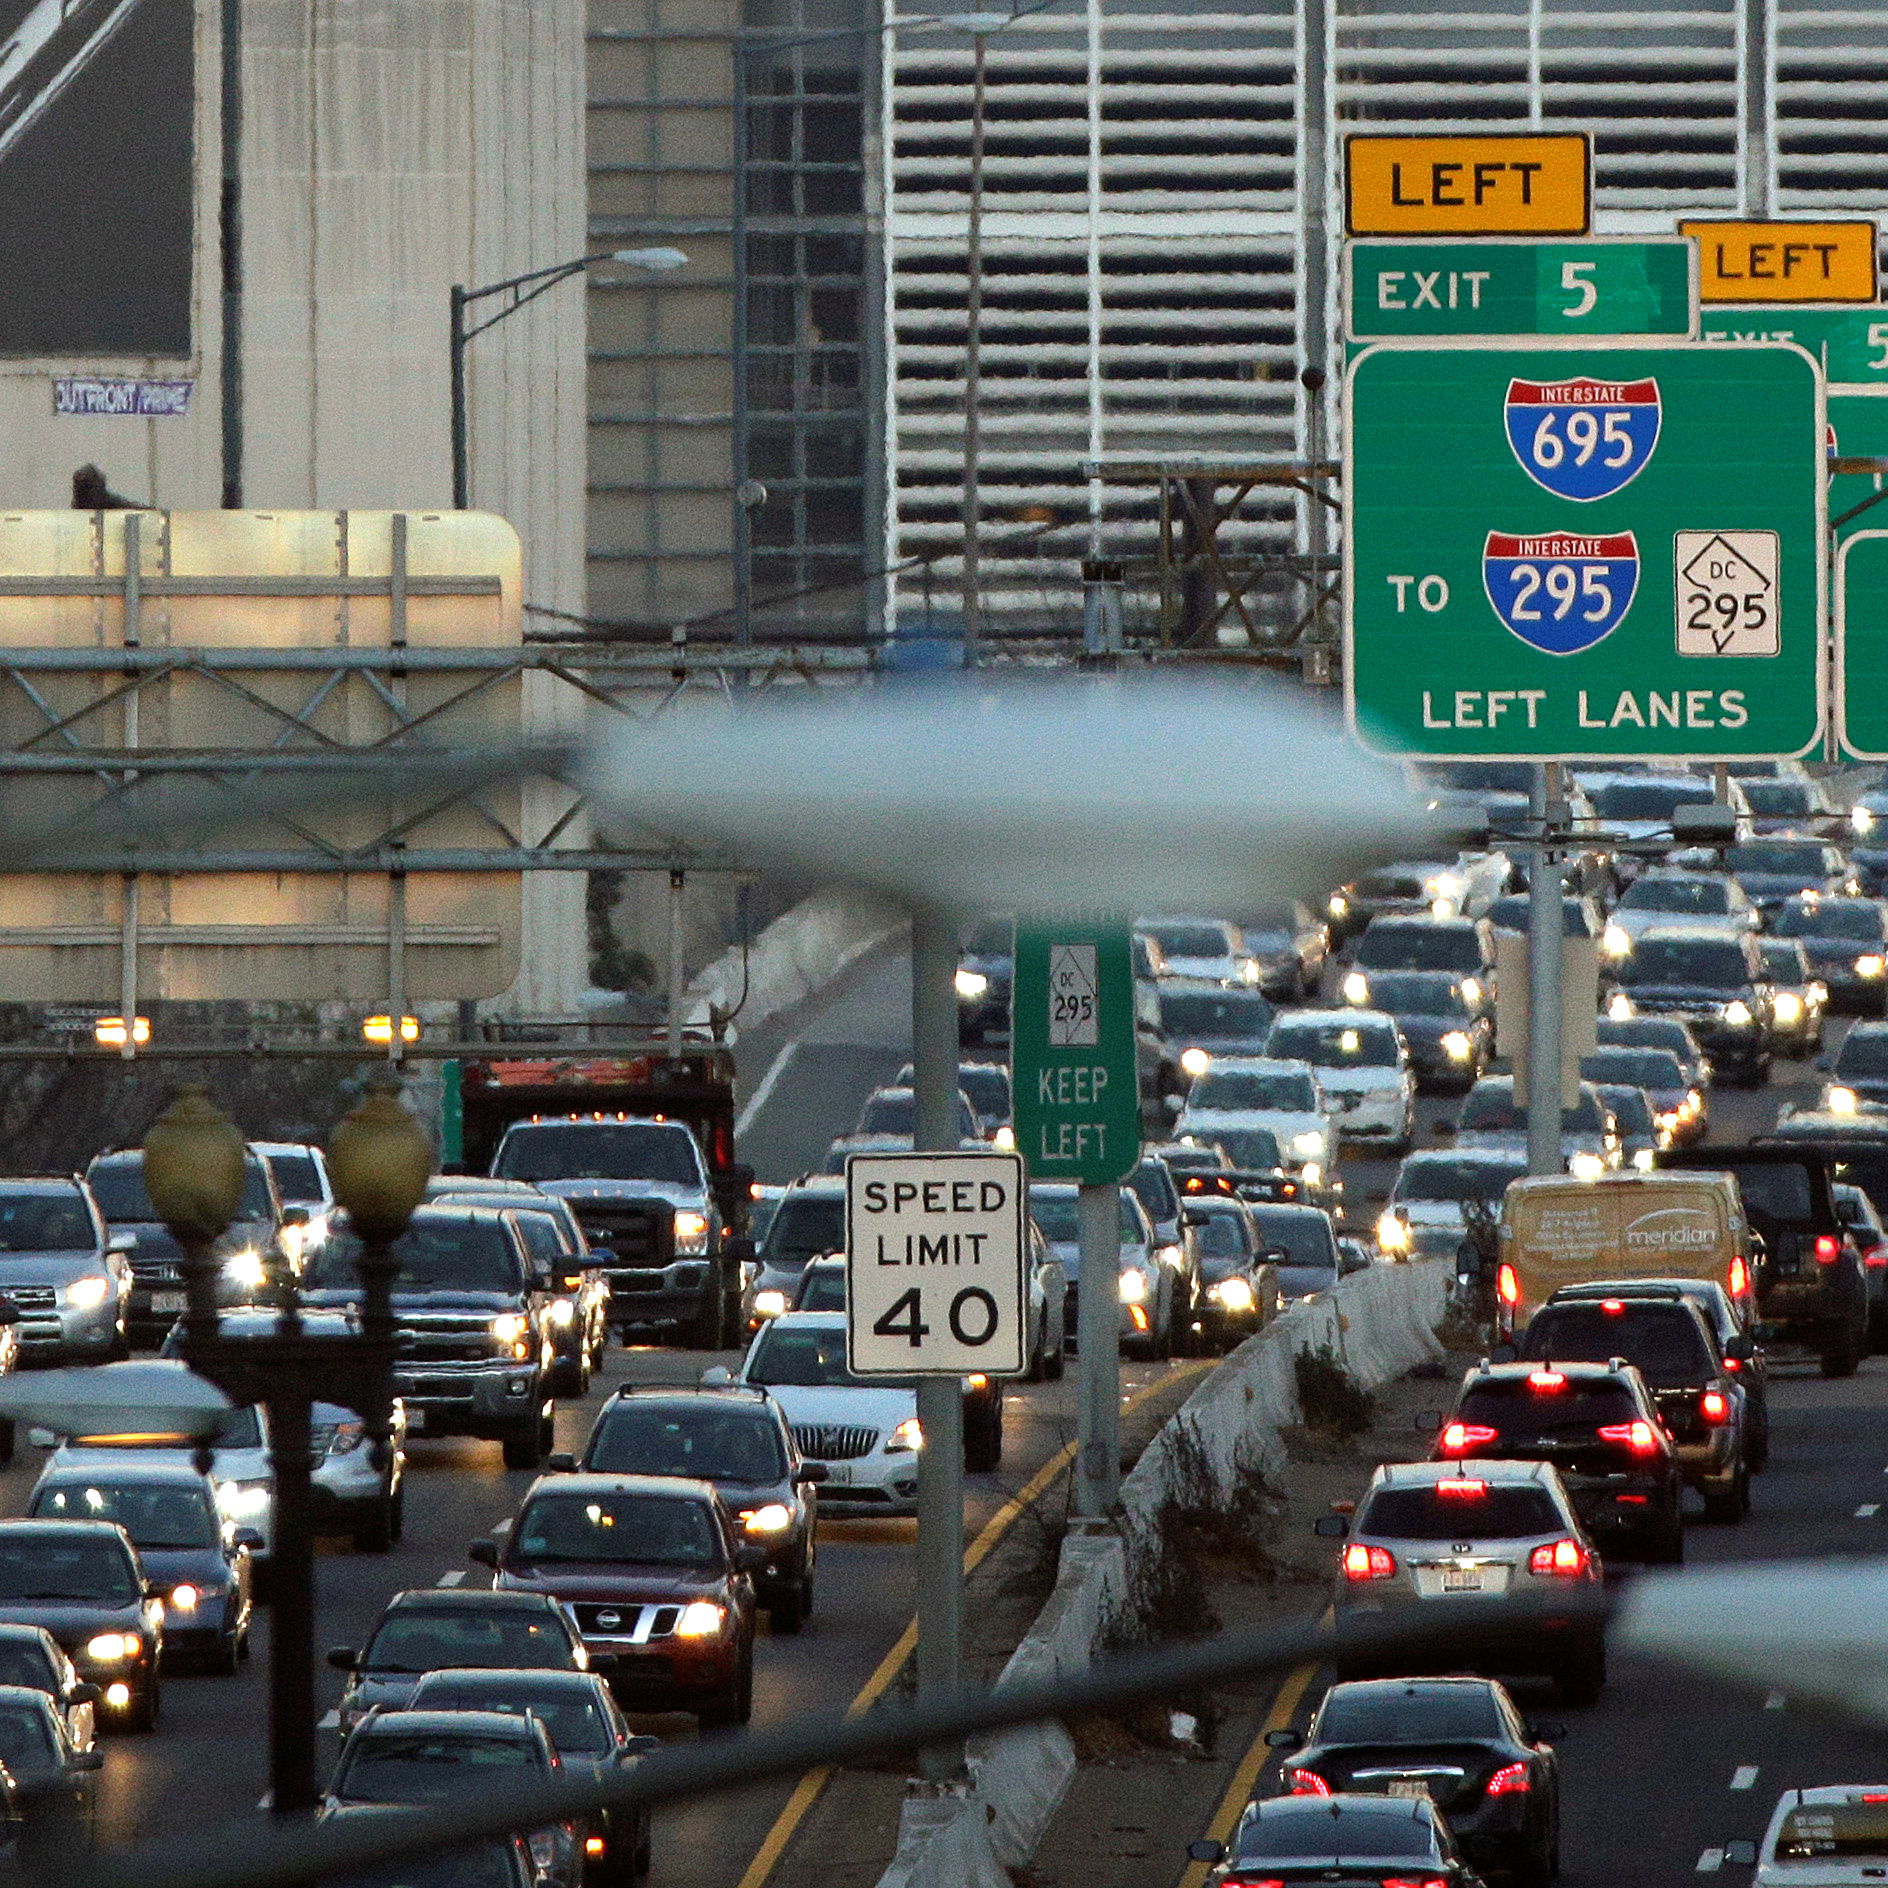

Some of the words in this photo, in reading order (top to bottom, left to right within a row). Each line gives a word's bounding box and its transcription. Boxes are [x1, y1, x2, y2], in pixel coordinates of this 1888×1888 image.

[1392, 164, 1541, 206] LEFT
[1716, 244, 1838, 279] LEFT
[1377, 272, 1490, 309] EXIT
[1561, 263, 1598, 315] 5
[1541, 386, 1624, 403] INTERSTATE
[1533, 413, 1633, 468] 695
[1519, 538, 1602, 556] INTERSTATE
[1711, 560, 1737, 581] DC
[1387, 576, 1448, 612] TO
[1511, 565, 1612, 620] 295
[1687, 594, 1766, 630] 295
[1423, 691, 1546, 728] LEFT
[1579, 691, 1748, 728] LANES
[1060, 972, 1074, 987] DC
[1054, 995, 1092, 1022] 295
[1039, 1067, 1109, 1104] KEEP
[1041, 1124, 1107, 1160] LEFT
[864, 1181, 1006, 1213] SPEED
[878, 1234, 988, 1265] LIMIT
[1626, 1226, 1717, 1244] meridian
[873, 1286, 999, 1348] 40
